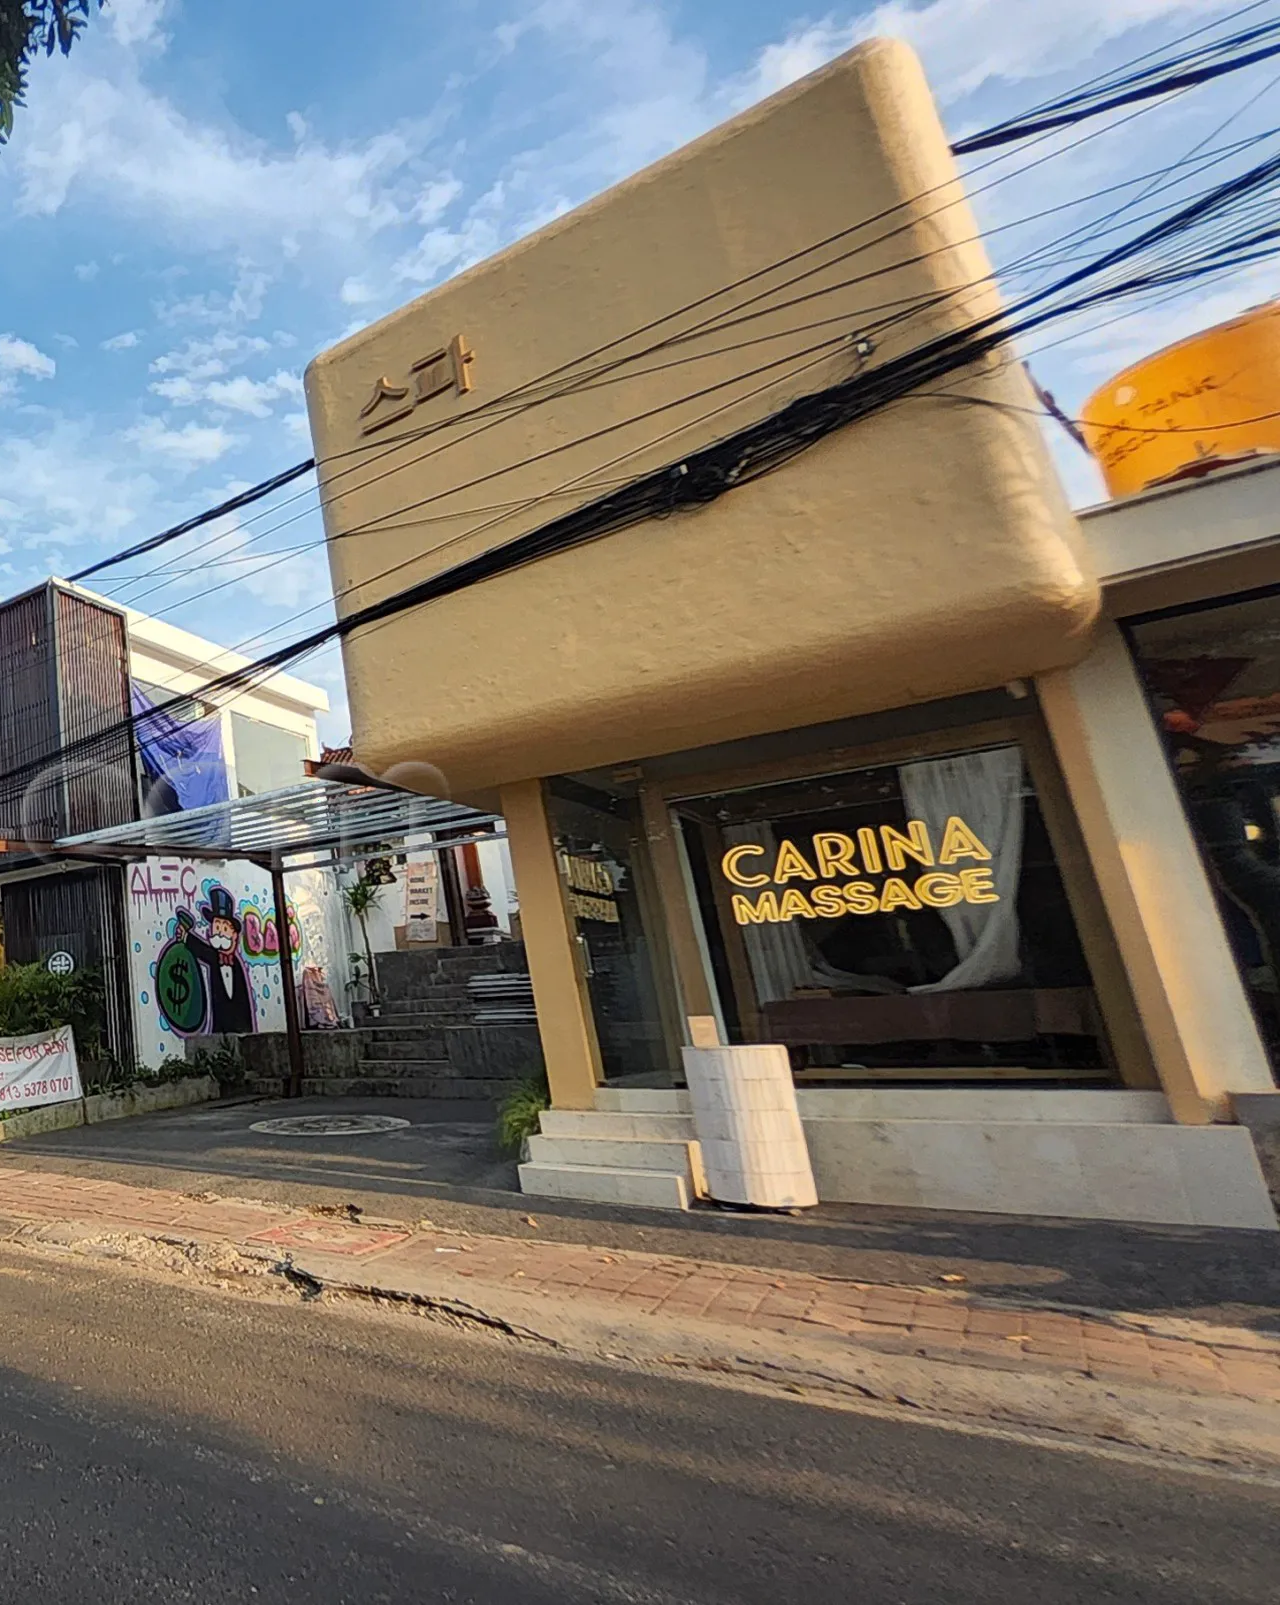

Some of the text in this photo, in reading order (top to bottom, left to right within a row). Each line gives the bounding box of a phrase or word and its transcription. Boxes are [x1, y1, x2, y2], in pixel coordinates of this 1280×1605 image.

[359, 333, 475, 438] 스파
[721, 816, 993, 889] CARINA
[131, 864, 198, 899] ALEC
[731, 867, 1001, 926] MASSAGE
[15, 1045, 40, 1061] FOR
[42, 1038, 70, 1055] RENT
[24, 1080, 48, 1097] 5378
[50, 1076, 73, 1093] 0707
